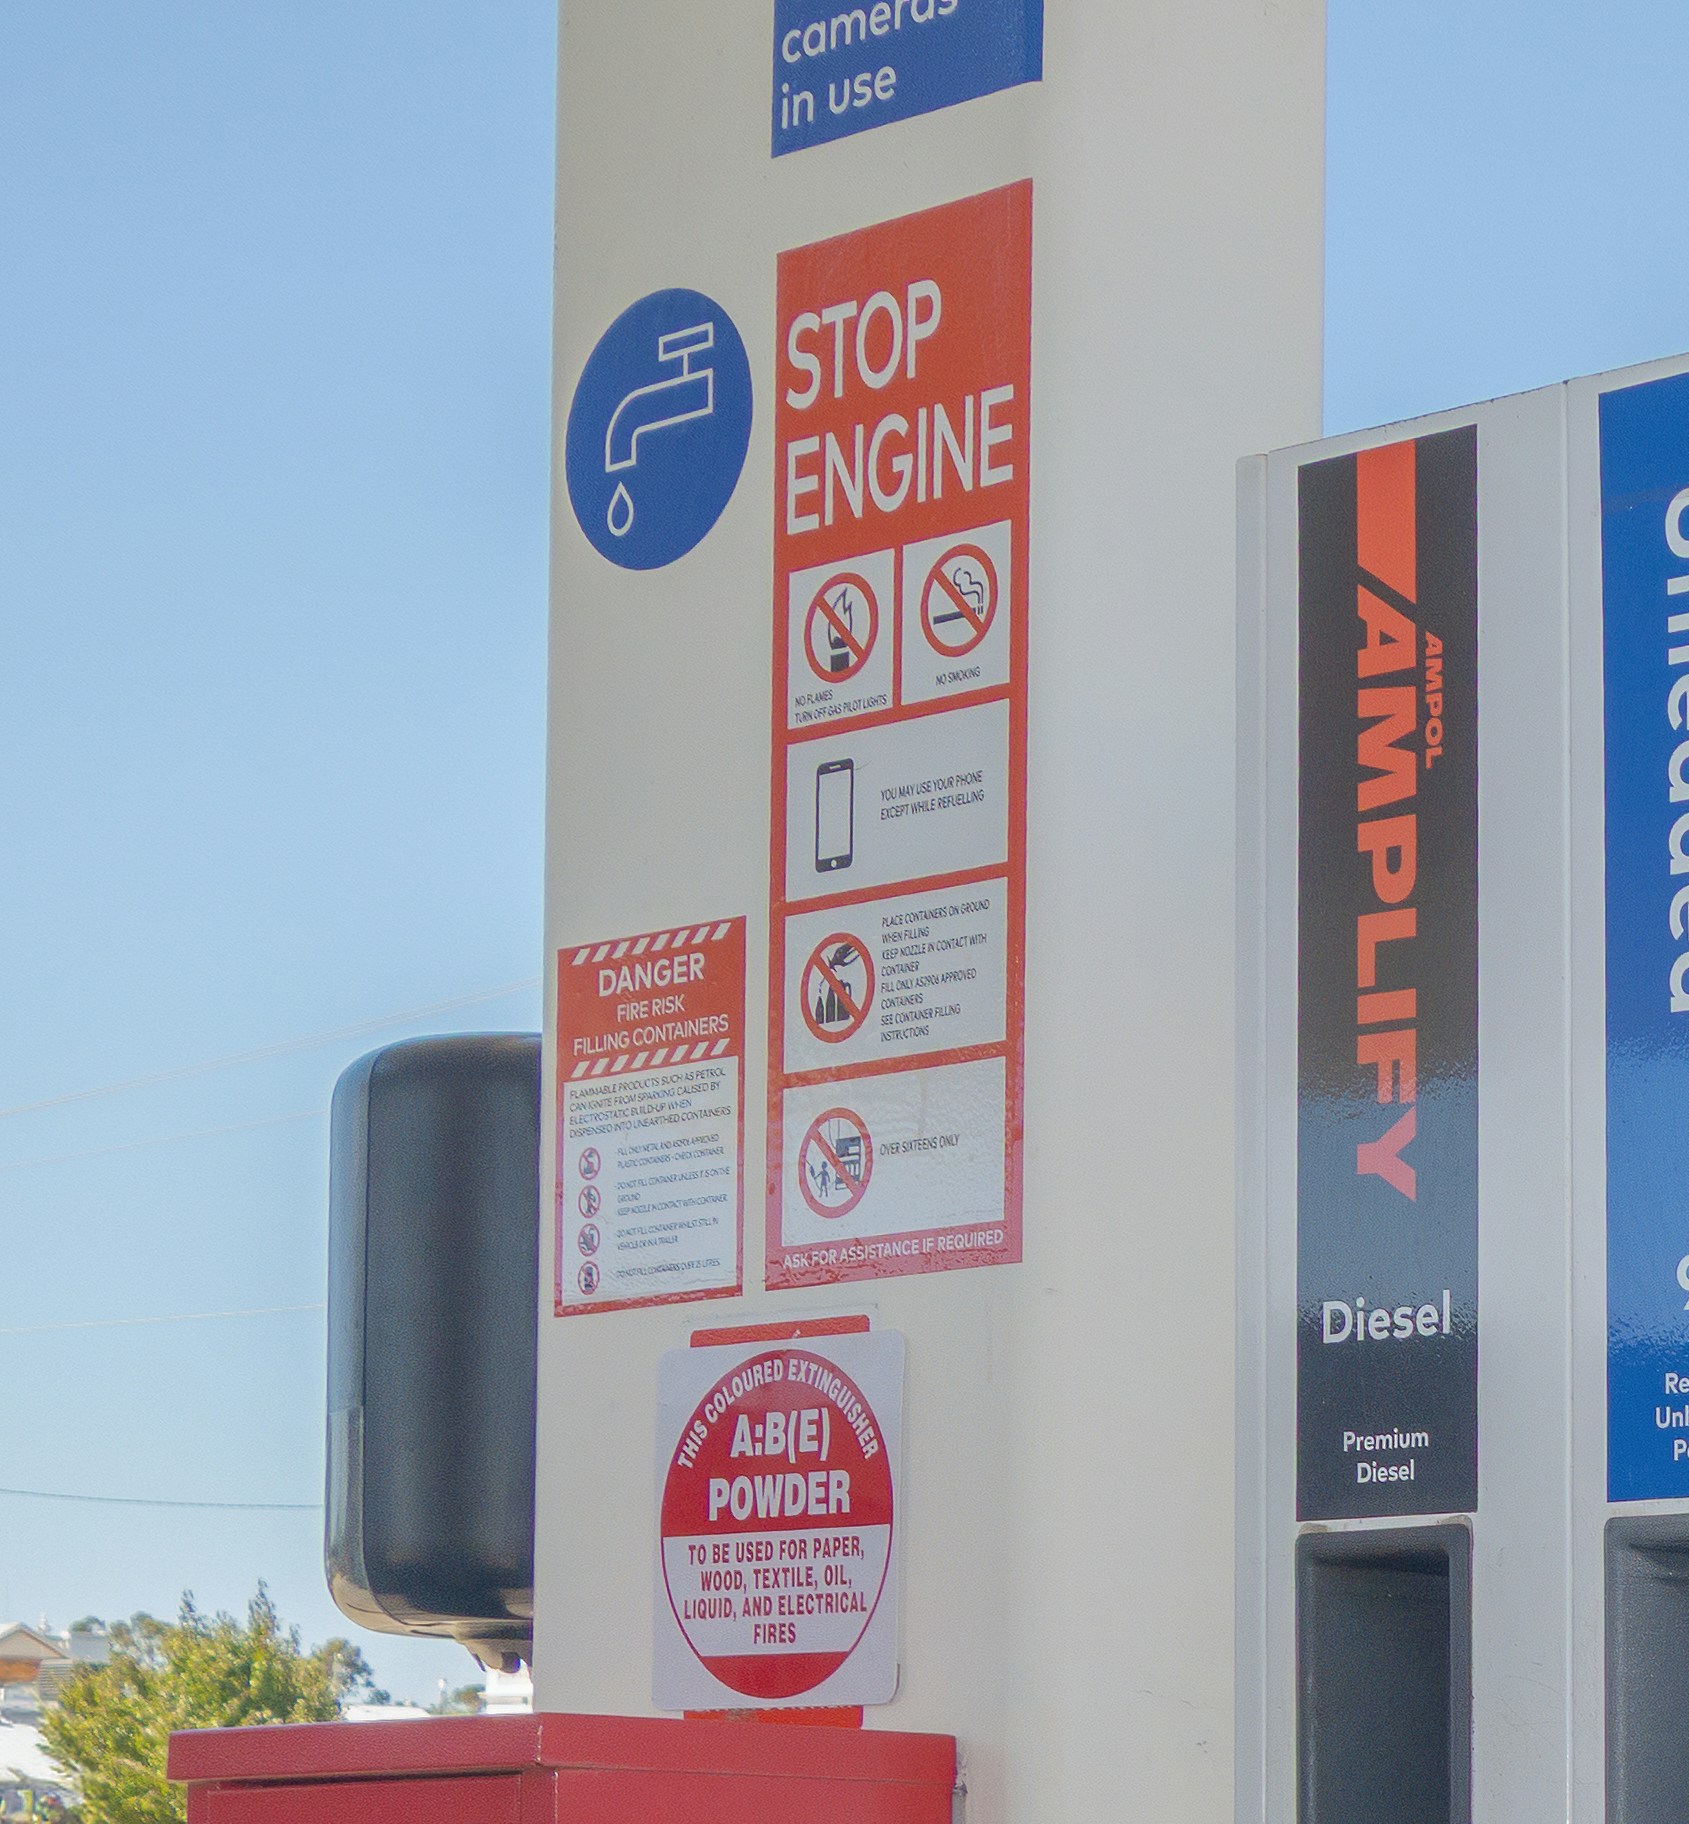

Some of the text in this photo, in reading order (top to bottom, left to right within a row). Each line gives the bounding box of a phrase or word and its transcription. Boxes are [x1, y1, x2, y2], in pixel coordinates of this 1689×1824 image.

[782, 66, 897, 129] in use
[786, 279, 943, 409] STOP
[786, 385, 1014, 535] ENGINE
[936, 666, 981, 686] NO SMOKING
[795, 689, 833, 708] NO FLAMES
[1424, 630, 1444, 769] AMPOL
[881, 770, 983, 801] YOU MAY USE YOUR PHONE
[881, 789, 985, 820] EXCEPT WHILE REFUELLING
[1357, 583, 1417, 1201] AMPLIFY
[599, 952, 705, 997] DANGER
[617, 994, 685, 1023] FIRE RISK
[574, 1014, 729, 1057] FILLING CONTAINERS
[880, 1134, 960, 1155] OVER SIXTEENS ONLY
[783, 1229, 1004, 1269] ASK FOR ASSISTANCE IF REQUIRED
[1322, 1289, 1452, 1345] Diesel
[677, 1358, 879, 1471] THIS COLOURED EXTINGUISHER
[730, 1407, 830, 1464] A:B(E)
[1342, 1427, 1430, 1455] Premium
[1355, 1458, 1416, 1485] Diesel
[708, 1469, 850, 1522] POWDER
[688, 1535, 864, 1565] TO BE USED FOR PAPER,
[701, 1564, 852, 1593] WOOD, TEXTILE, OIL,
[684, 1591, 867, 1622] LIQUID, AND ELECTRICAL
[753, 1623, 797, 1644] FIRES
